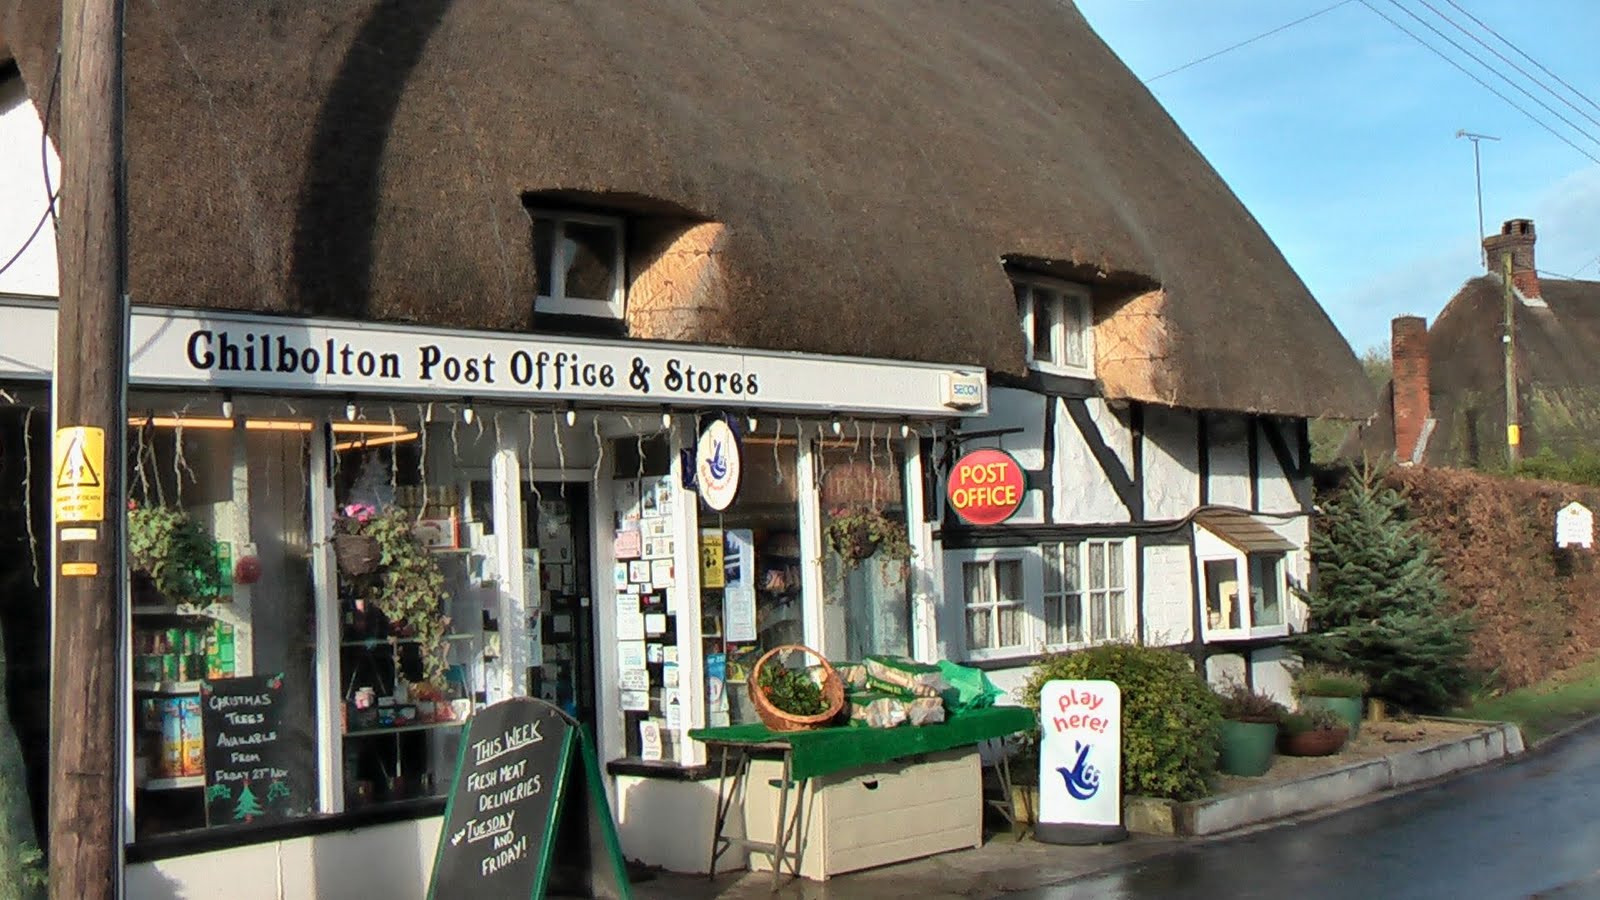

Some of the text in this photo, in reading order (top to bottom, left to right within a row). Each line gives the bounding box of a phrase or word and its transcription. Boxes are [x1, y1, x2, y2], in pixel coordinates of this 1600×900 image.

[187, 329, 759, 395] Chilbolton Post Office & Stores
[960, 463, 1008, 486] POST
[952, 485, 1016, 508] OFFICE
[1058, 688, 1104, 712] play
[224, 711, 265, 725] TREES
[1053, 714, 1109, 734] here!
[216, 731, 277, 747] AVAILABLE
[472, 720, 543, 761] THIS WEEK
[231, 751, 261, 763] FROM
[467, 759, 527, 792] FRESH MEAT
[478, 774, 542, 812] DELIVERIES
[466, 809, 515, 840] TUESDAY
[493, 830, 515, 850] AND
[482, 835, 527, 877] FRIDAY!
